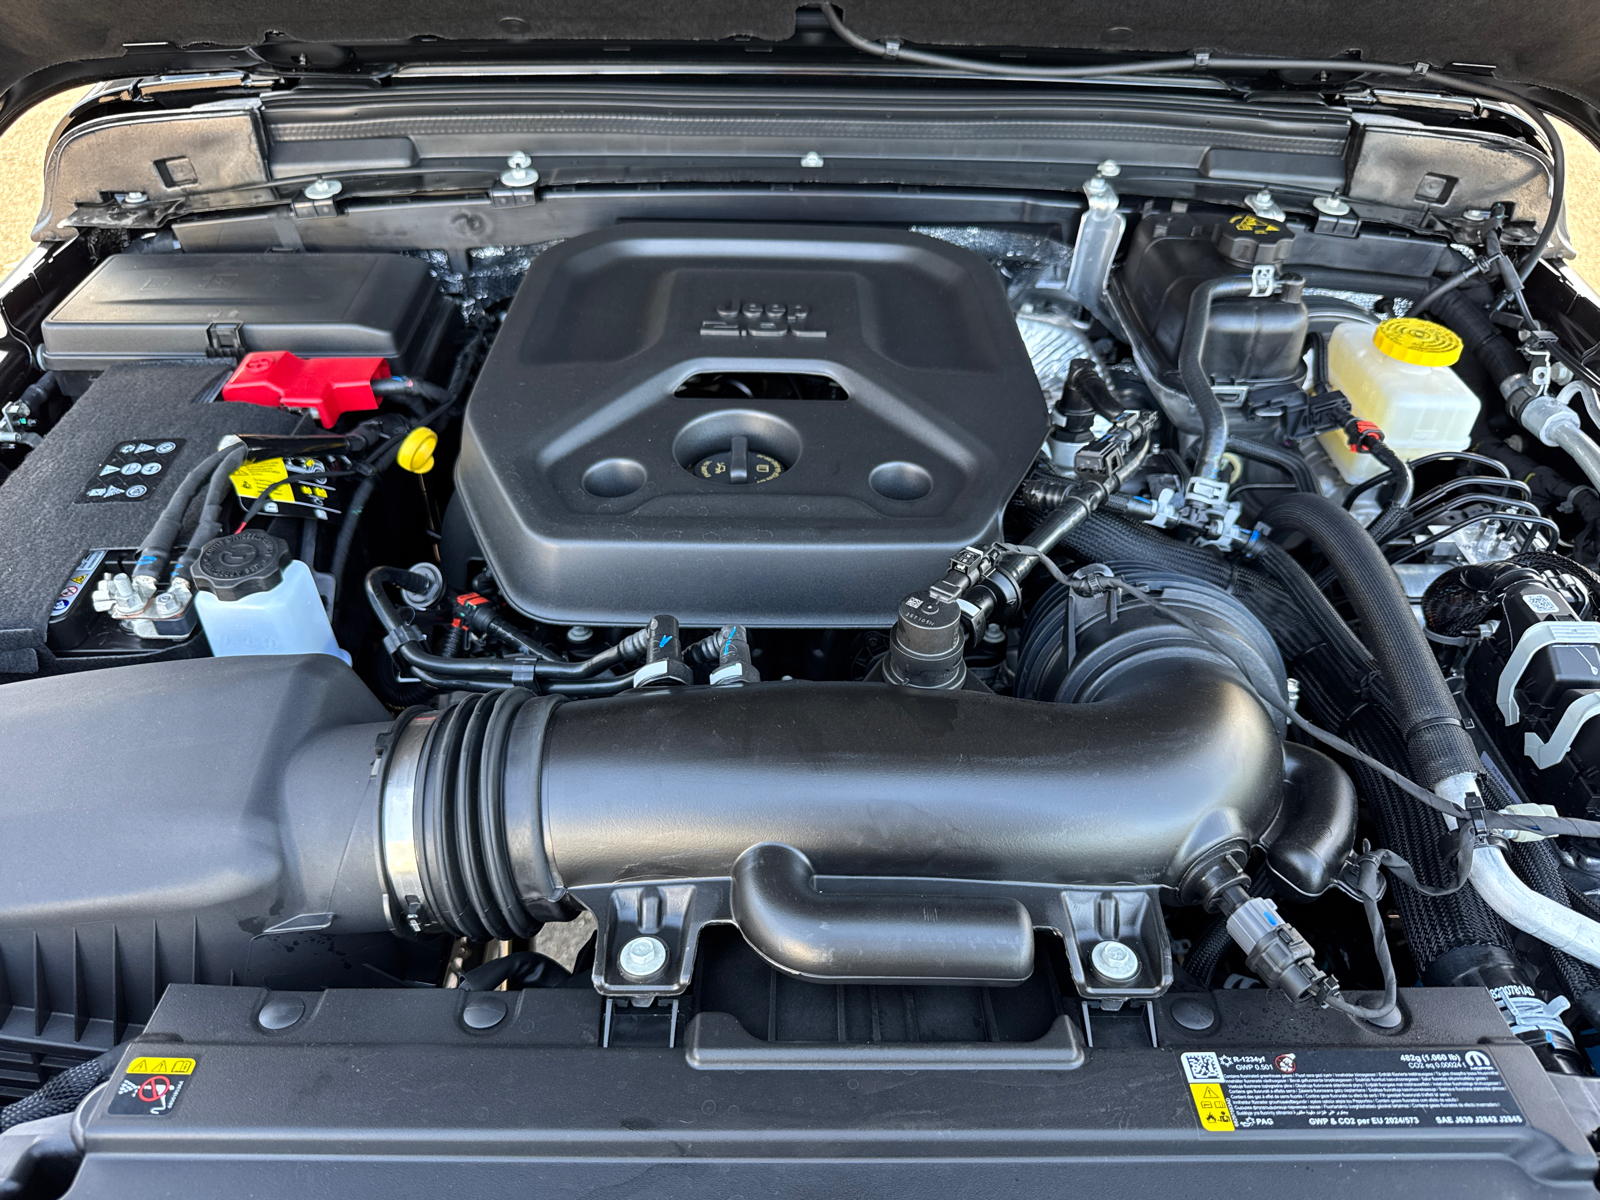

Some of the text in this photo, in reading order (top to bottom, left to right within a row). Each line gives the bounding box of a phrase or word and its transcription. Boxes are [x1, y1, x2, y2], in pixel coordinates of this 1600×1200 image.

[716, 299, 809, 322] Jeep
[1254, 1063, 1274, 1071] 0.501
[1256, 1118, 1274, 1126] PAG
[1308, 1117, 1329, 1126] GWP
[1330, 1117, 1338, 1125] &
[1338, 1117, 1356, 1125] CO2
[1357, 1118, 1370, 1127] per
[1371, 1117, 1384, 1125] EU
[1435, 1116, 1454, 1124] SAE
